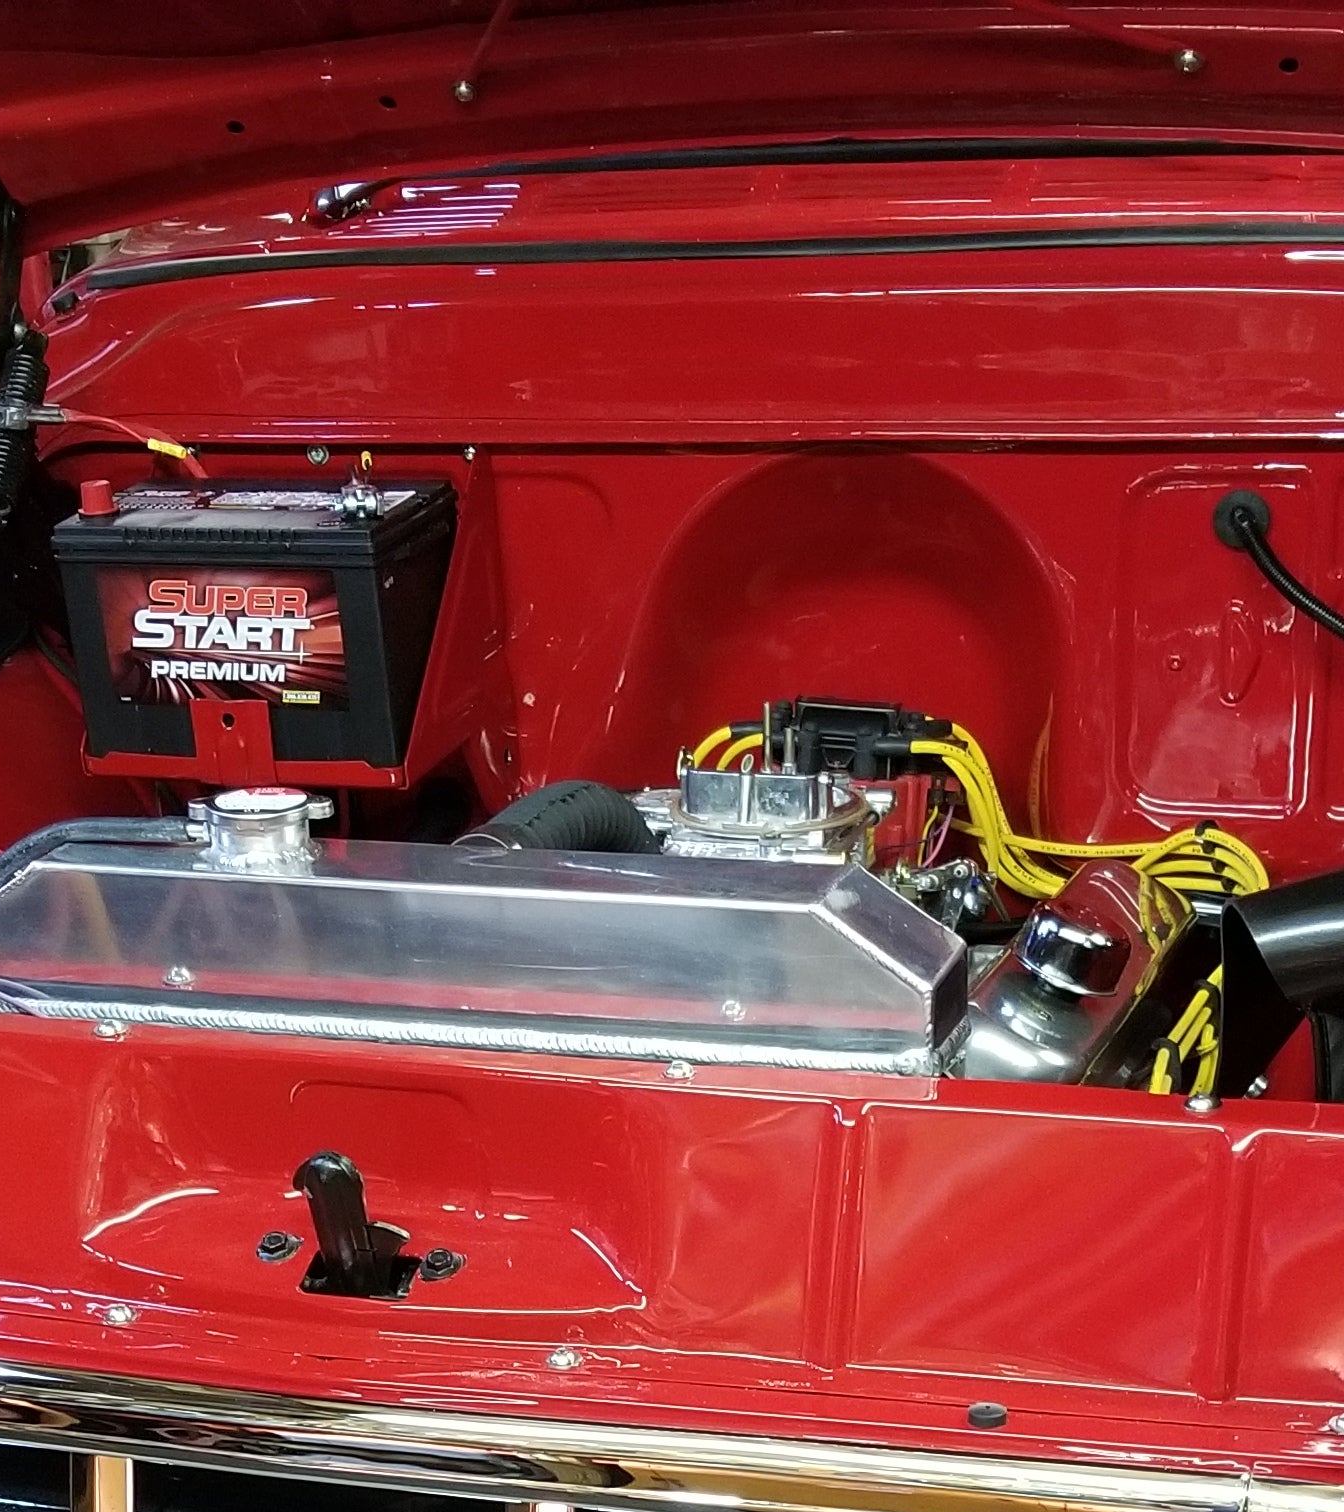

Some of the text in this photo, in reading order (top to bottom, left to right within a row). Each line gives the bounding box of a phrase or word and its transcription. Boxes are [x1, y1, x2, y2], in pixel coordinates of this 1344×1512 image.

[148, 579, 308, 618] SUPER
[131, 609, 312, 652] START
[150, 660, 287, 683] PREMIUM
